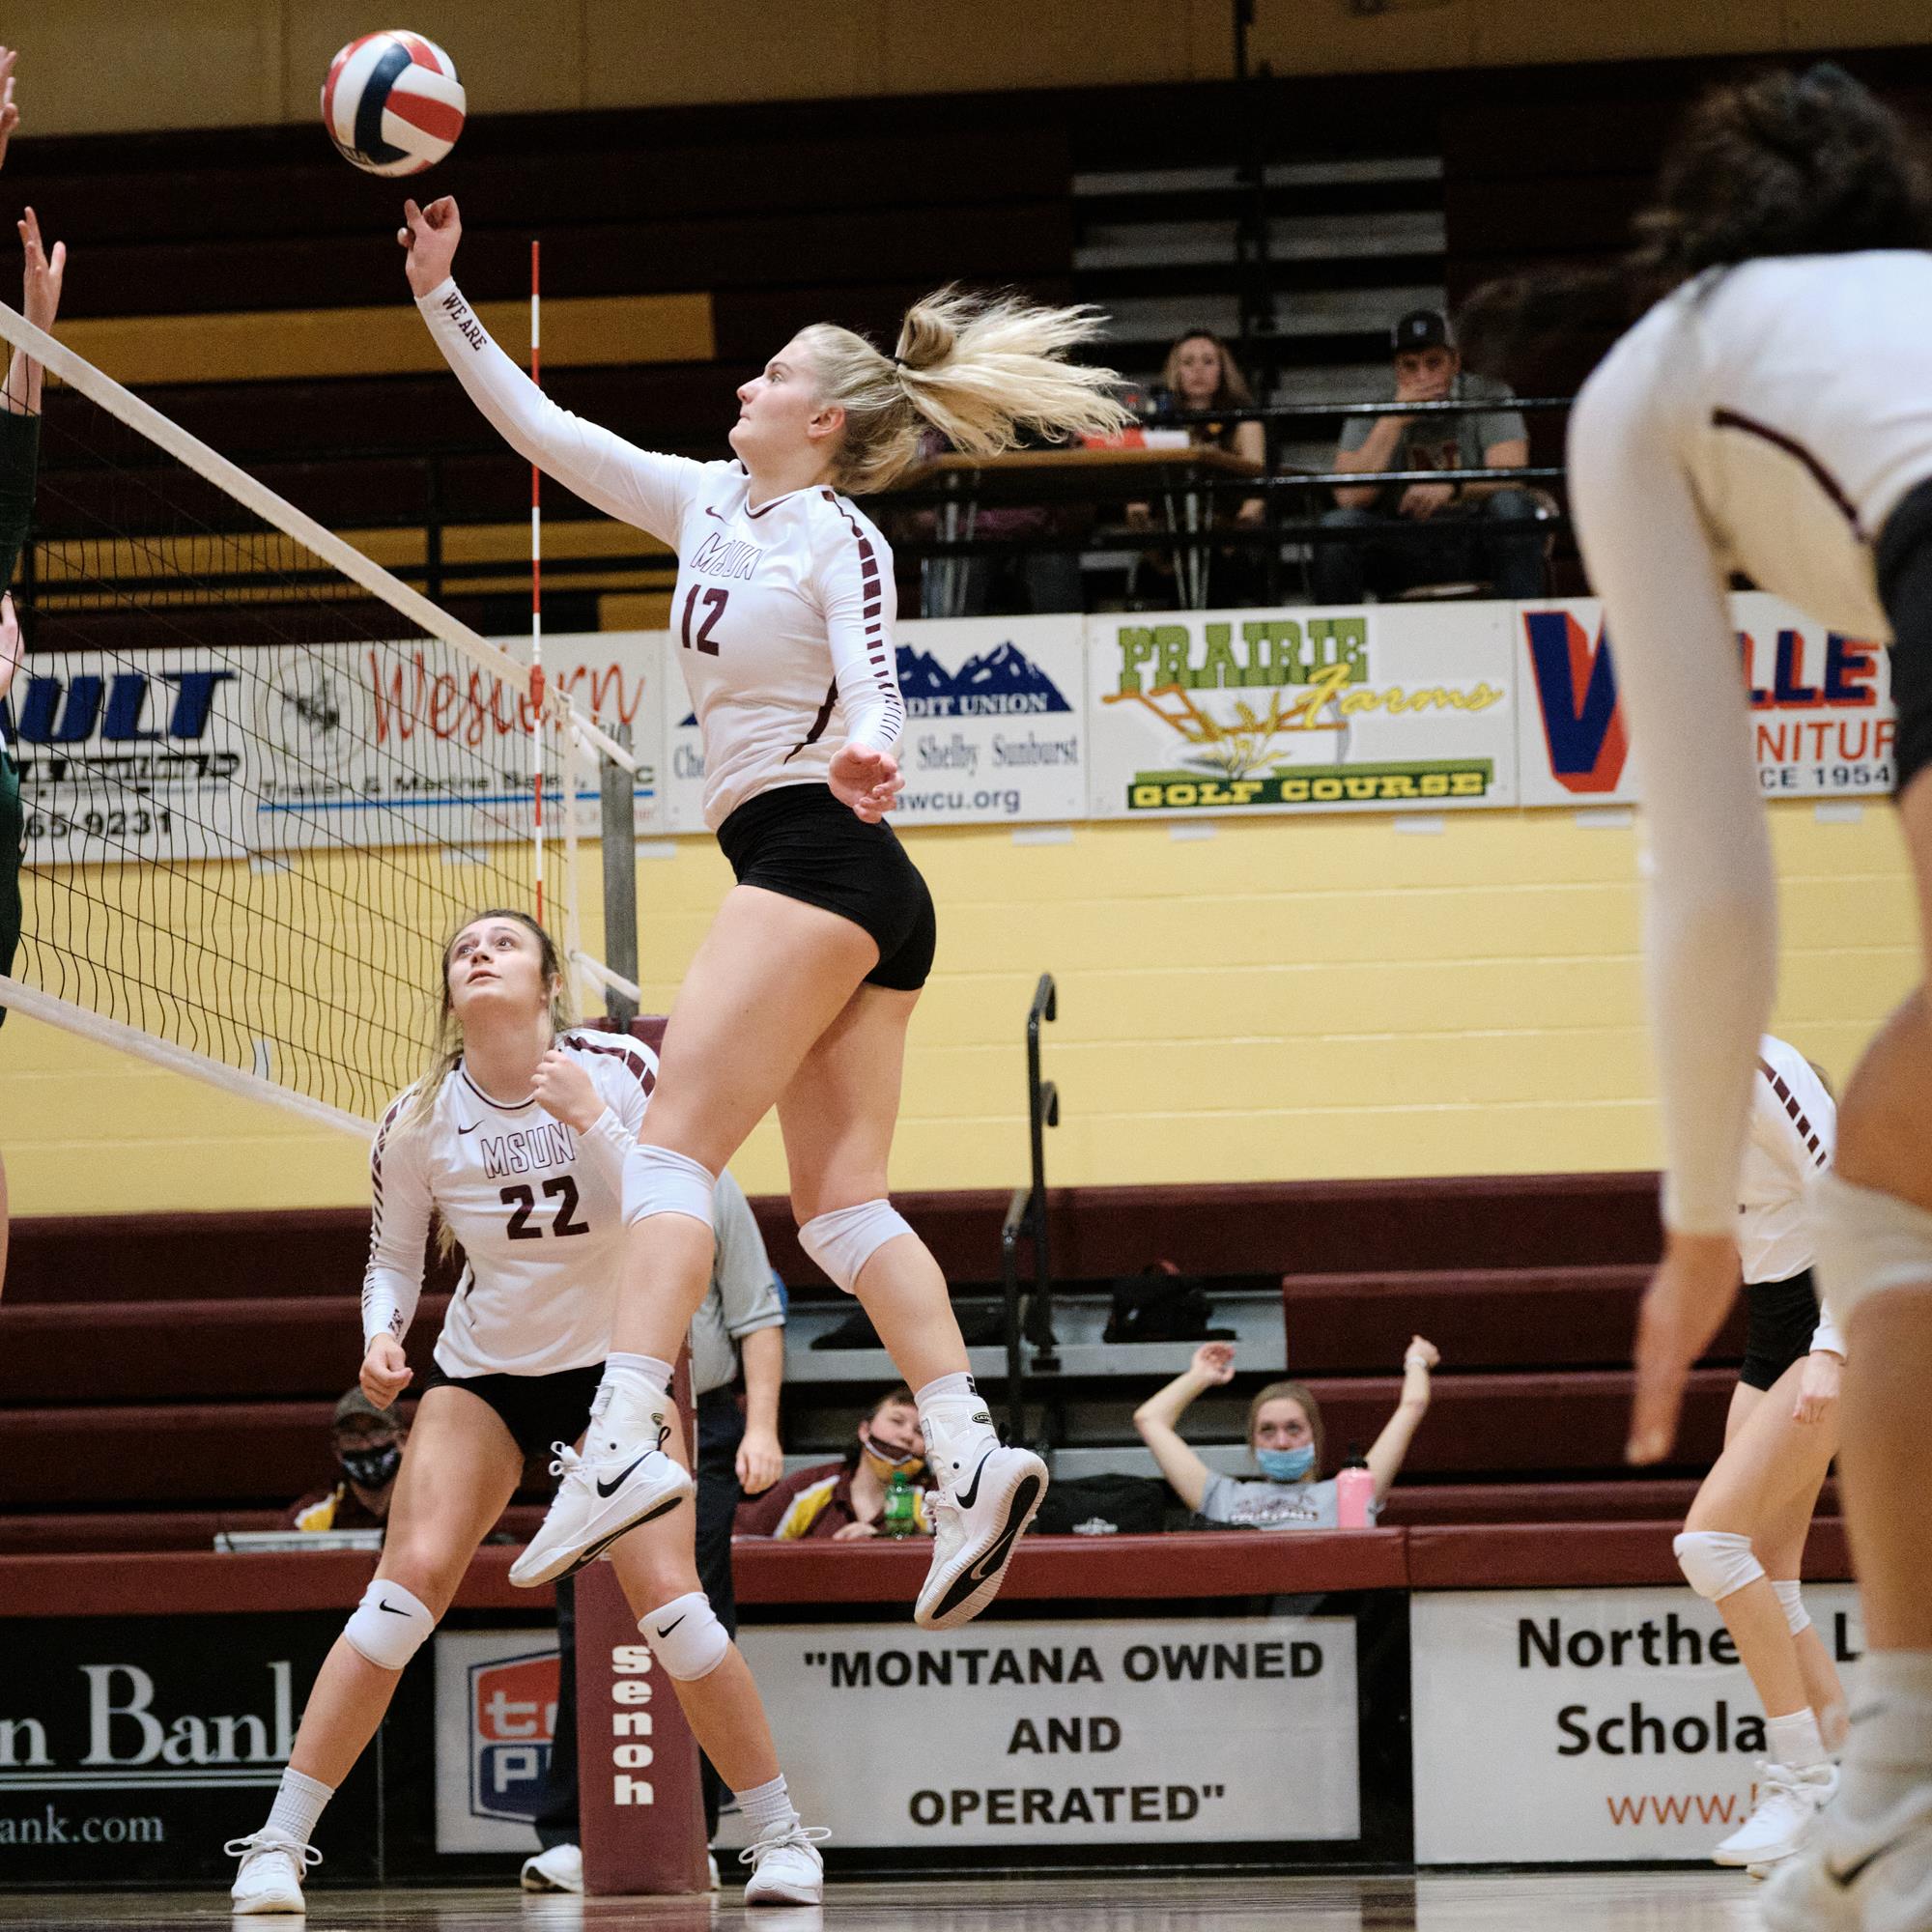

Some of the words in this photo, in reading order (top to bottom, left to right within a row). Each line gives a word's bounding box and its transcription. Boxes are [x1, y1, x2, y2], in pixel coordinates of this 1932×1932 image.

[442, 292, 468, 321] WE
[458, 319, 487, 351] ARE
[682, 583, 729, 657] 12
[1119, 617, 1368, 692] PRAIRIE
[0, 670, 238, 745] ULT
[905, 695, 957, 718] DIT
[958, 691, 1048, 716] UNION
[1295, 664, 1504, 729] Farms
[918, 733, 980, 777] Shelby
[992, 730, 1078, 768] Sunburst
[1812, 763, 1890, 787] 1954
[1134, 781, 1264, 809] GOLF
[1281, 772, 1485, 802] COURSE
[481, 1122, 577, 1179] MSUN
[499, 1175, 590, 1240] 22
[804, 1645, 1104, 1688] "MONTANA
[1122, 1641, 1323, 1682] OWNED
[1008, 1717, 1122, 1755] AND
[1556, 1700, 1768, 1757] Schola
[909, 1785, 1226, 1827] OPERATED"
